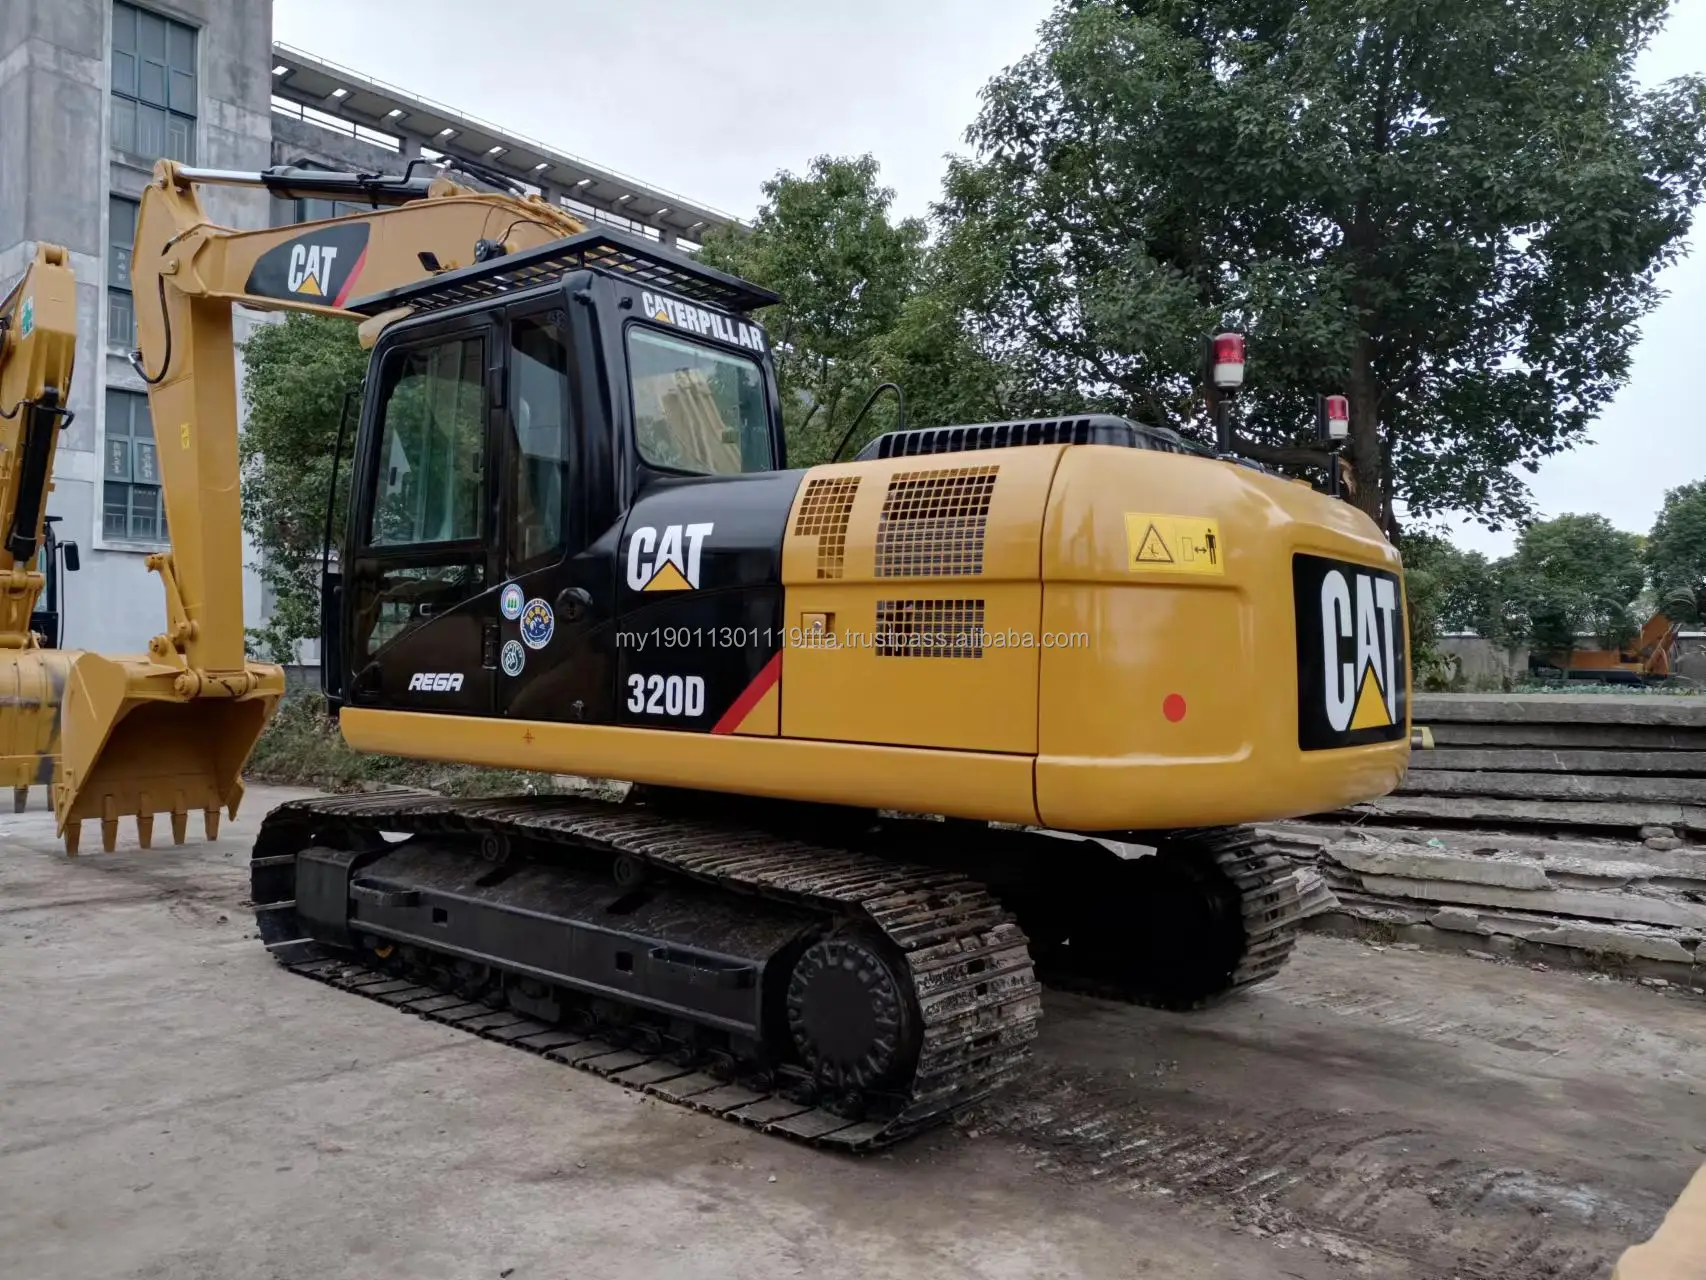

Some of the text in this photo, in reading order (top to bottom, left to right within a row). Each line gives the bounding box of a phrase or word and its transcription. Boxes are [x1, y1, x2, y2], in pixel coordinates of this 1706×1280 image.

[288, 244, 337, 295] CAT
[641, 292, 765, 352] CATERPILLAR
[626, 522, 714, 592] CAT
[1321, 569, 1396, 732] CAT
[626, 673, 705, 717] 320D
